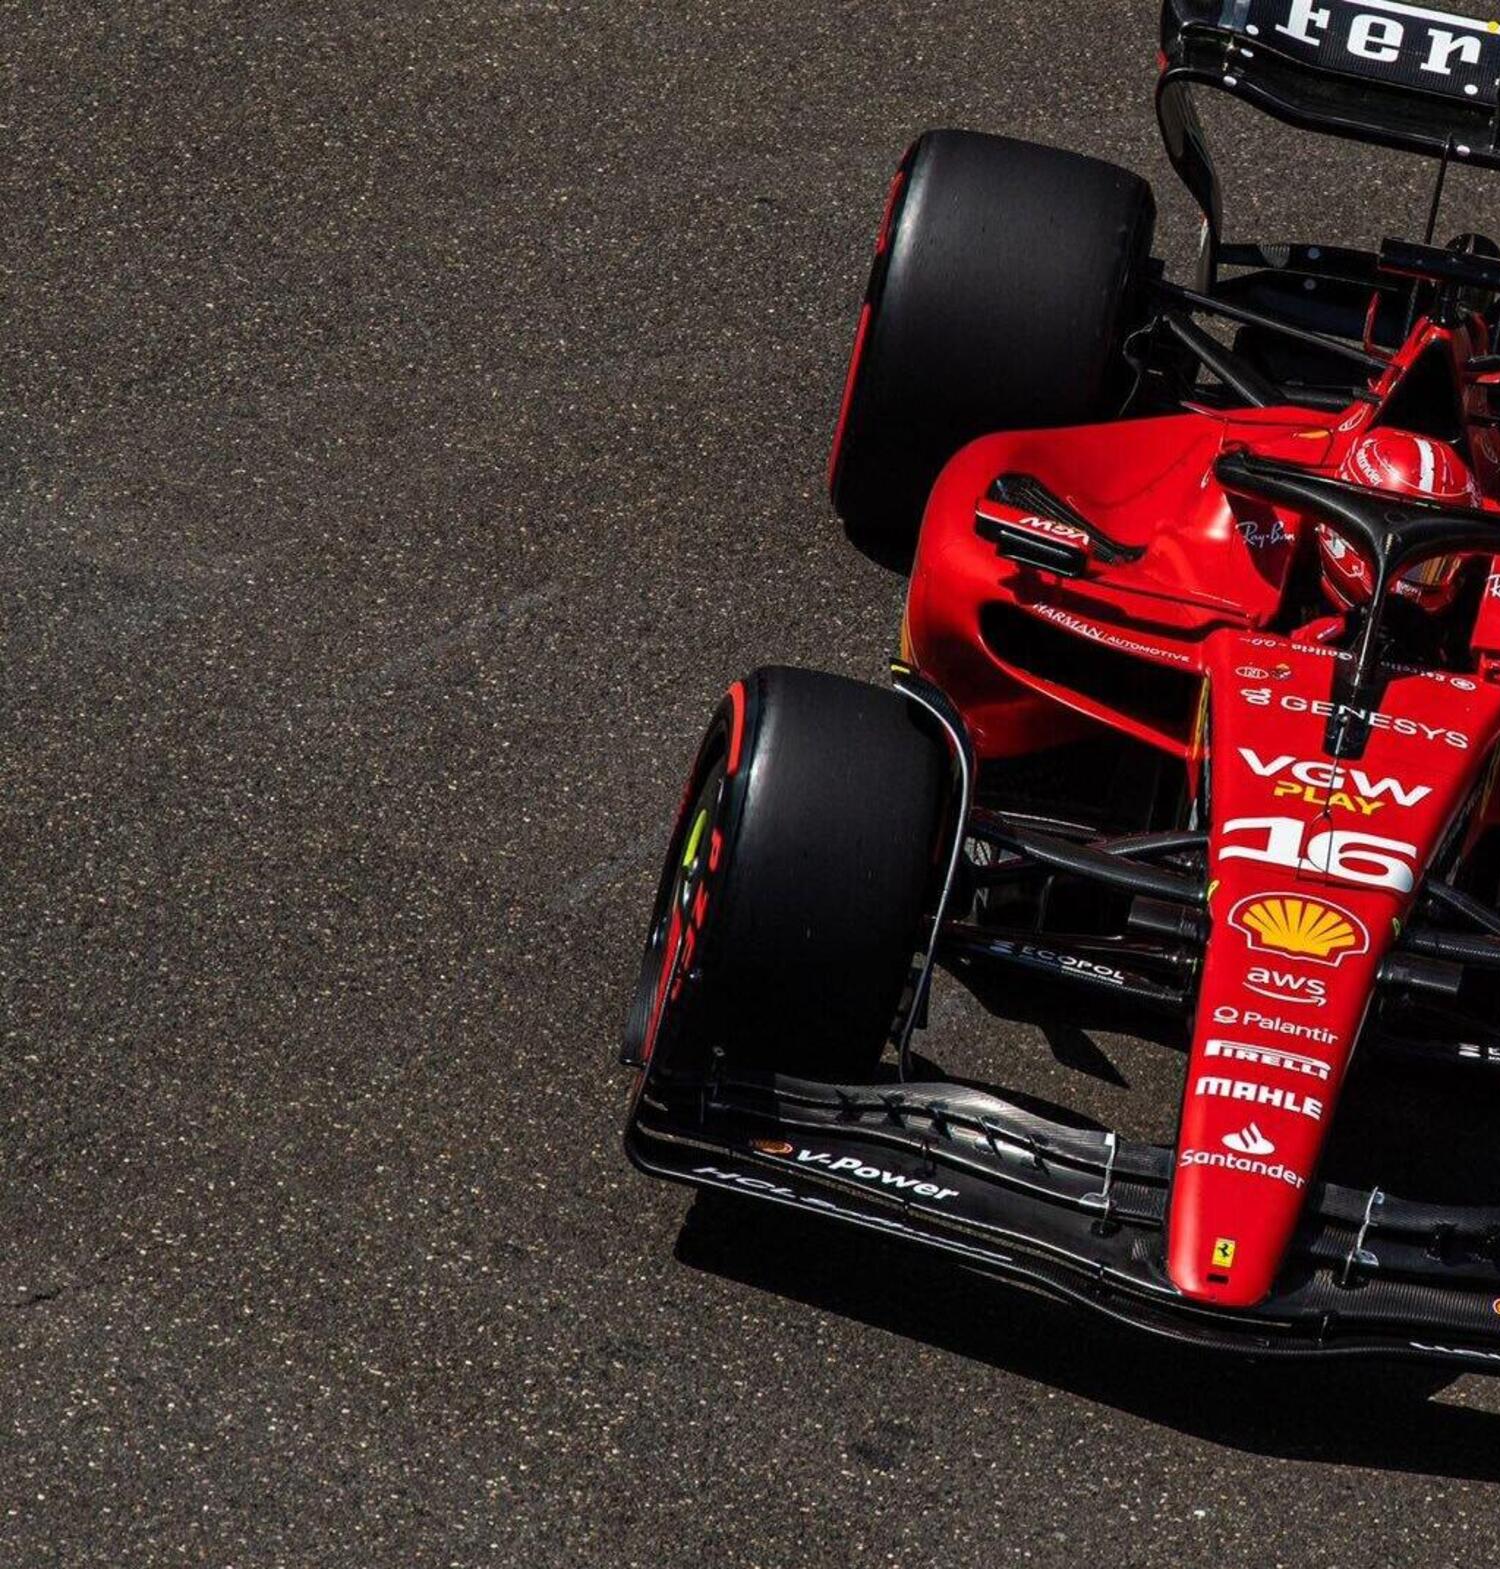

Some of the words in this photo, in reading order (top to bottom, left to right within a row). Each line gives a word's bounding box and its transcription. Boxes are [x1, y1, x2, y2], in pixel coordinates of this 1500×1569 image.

[1032, 601, 1102, 639] HARMAN
[1107, 636, 1191, 662] AUTOMOTIVE
[1281, 697, 1470, 749] GENESYS
[1237, 747, 1433, 807] VGW
[1273, 780, 1385, 815] PLAY
[1218, 816, 1418, 894] 16
[1247, 967, 1326, 996] aws
[1243, 1012, 1339, 1045] Palantir
[1205, 1039, 1331, 1080] PIRELLI
[1196, 1076, 1323, 1120] MAHLE
[797, 1149, 959, 1201] V-Power
[1180, 1149, 1305, 1190] Santander
